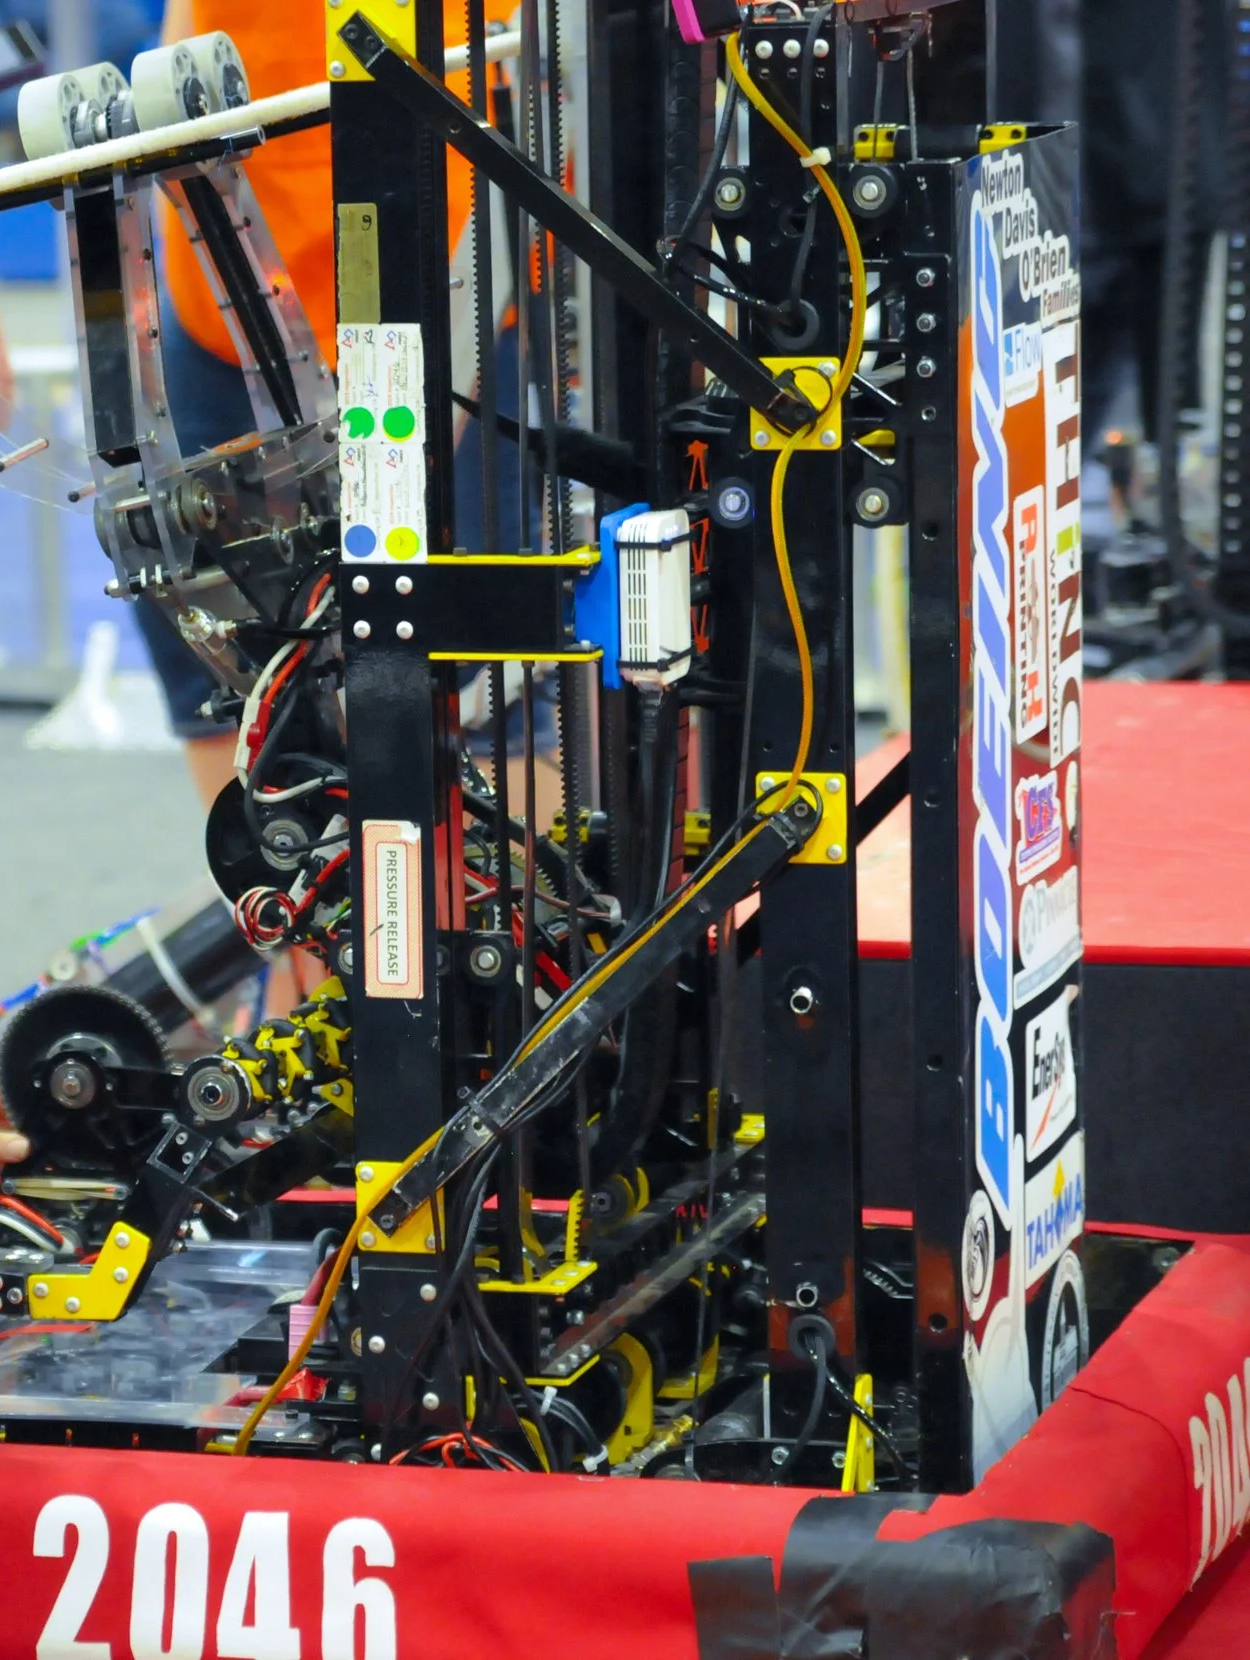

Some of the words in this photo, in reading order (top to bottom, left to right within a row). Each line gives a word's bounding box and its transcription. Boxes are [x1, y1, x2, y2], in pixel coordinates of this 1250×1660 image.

[981, 161, 1021, 207] Newton
[1004, 200, 1036, 248] Davis
[1022, 242, 1067, 288] O'Brien
[1042, 278, 1080, 318] Families
[1014, 325, 1042, 370] Flow
[1019, 540, 1029, 728] PRINTING
[1051, 550, 1059, 753] WORLDWIDE
[975, 208, 1009, 1211] BOEING
[386, 850, 398, 916] PRESSURE
[386, 921, 398, 976] RELEASE
[32, 1494, 397, 1660] 2046
